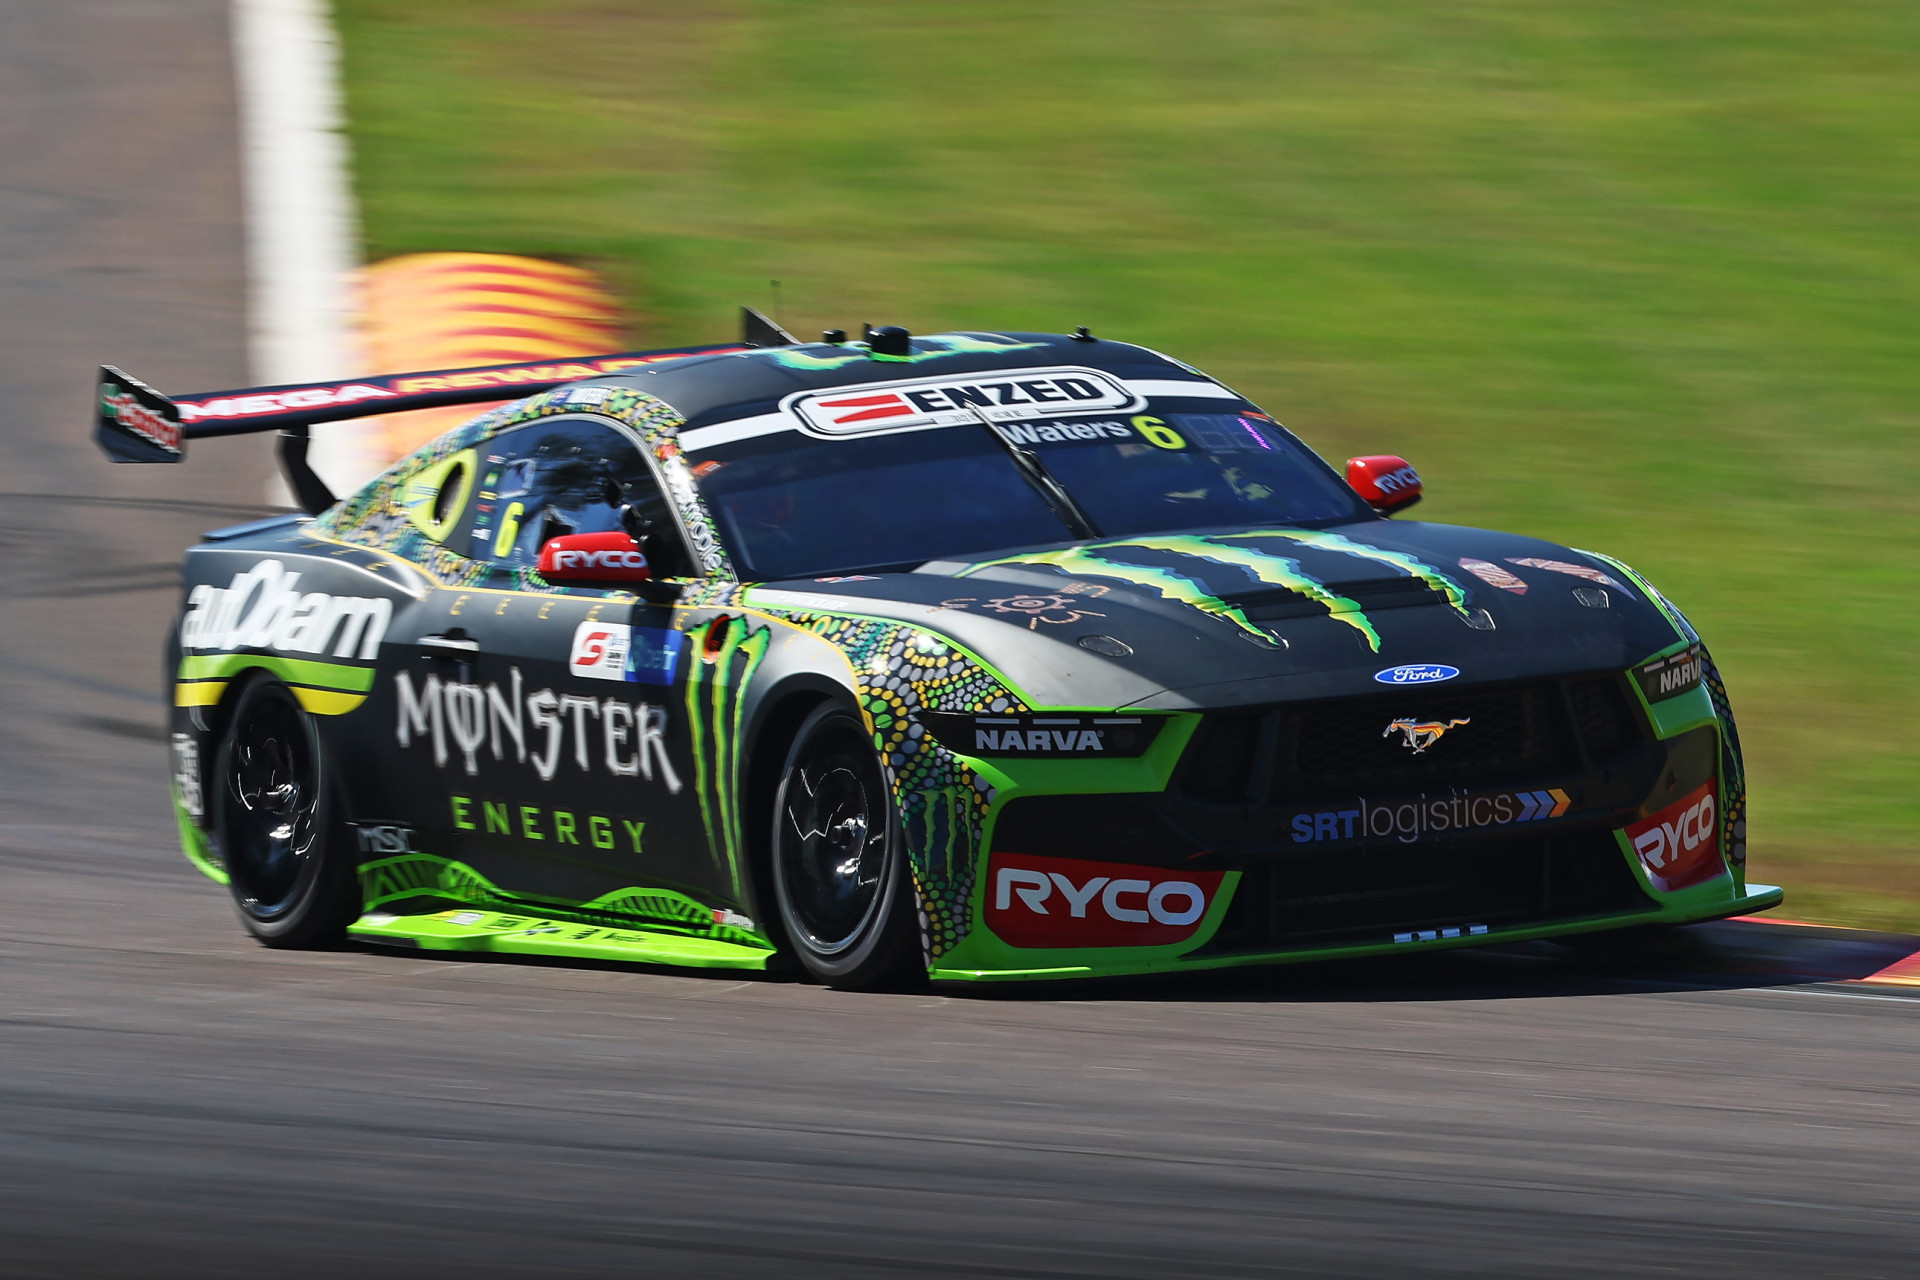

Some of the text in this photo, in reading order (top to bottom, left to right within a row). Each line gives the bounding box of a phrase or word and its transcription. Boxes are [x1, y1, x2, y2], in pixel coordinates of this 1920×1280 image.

[177, 384, 398, 420] MEGA
[906, 378, 1105, 413] ENZED
[1000, 415, 1187, 450] Waters 6
[1373, 466, 1423, 495] RYC
[494, 501, 525, 558] 6
[553, 550, 646, 571] RYCO
[1660, 656, 1701, 694] NARV
[395, 666, 684, 795] MONSTER
[451, 795, 647, 854] ENERGY
[1634, 794, 1715, 872] RYCO
[995, 867, 1205, 926] RYCO
